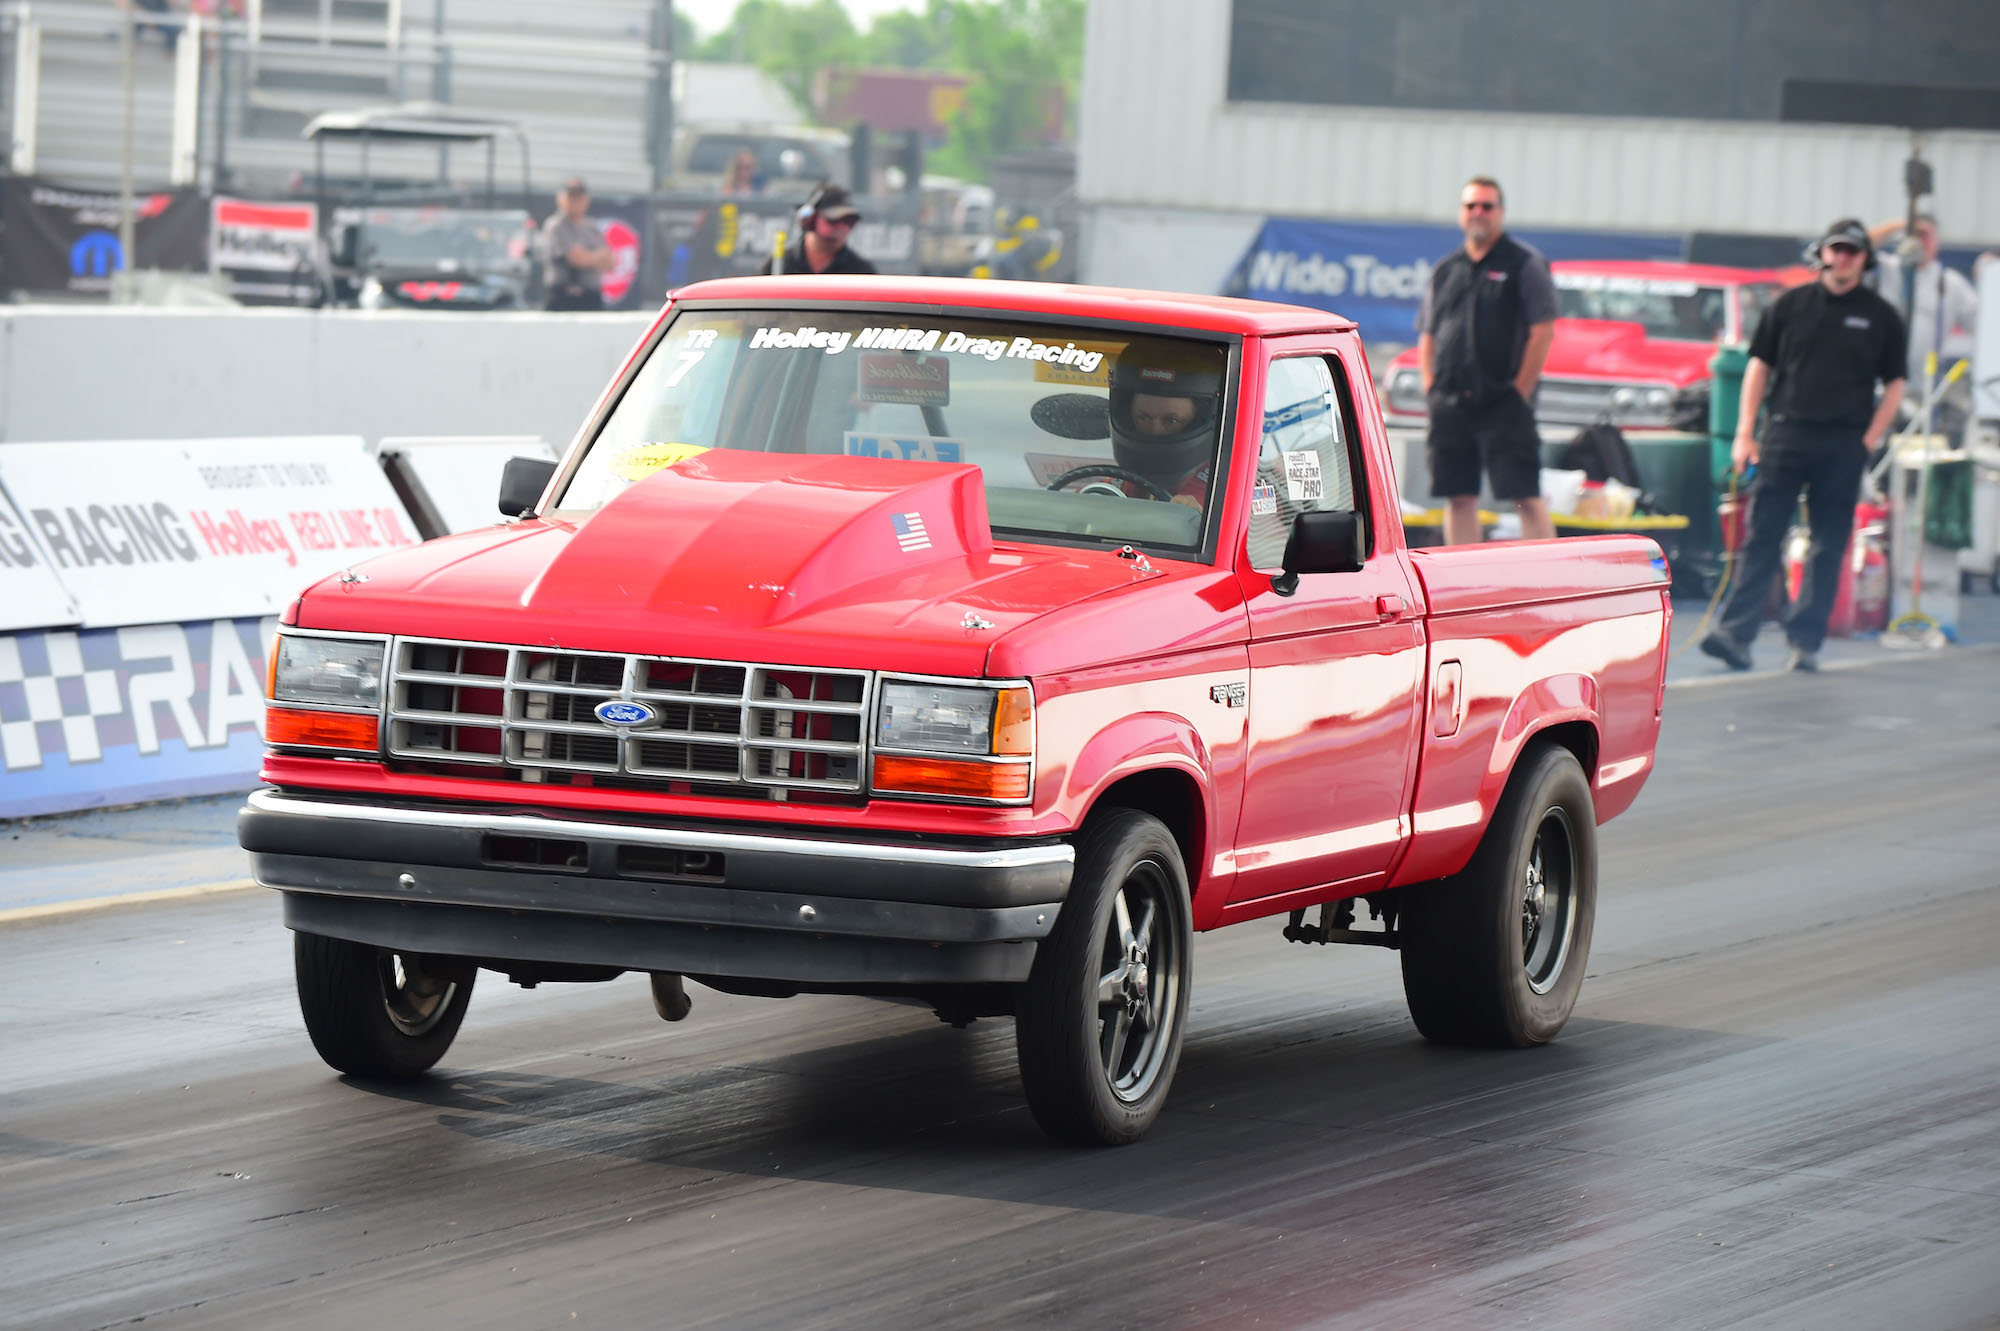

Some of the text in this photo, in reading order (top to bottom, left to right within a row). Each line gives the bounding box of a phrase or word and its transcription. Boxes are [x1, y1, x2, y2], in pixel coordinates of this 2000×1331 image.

[684, 329, 718, 348] TR
[749, 327, 1104, 372] Holley NMRA Drag Racing
[664, 351, 704, 387] 7
[1303, 480, 1321, 498] PRO
[31, 502, 199, 568] RACING
[190, 507, 413, 567] Holley RED LINE OIL
[606, 705, 641, 721] Ford
